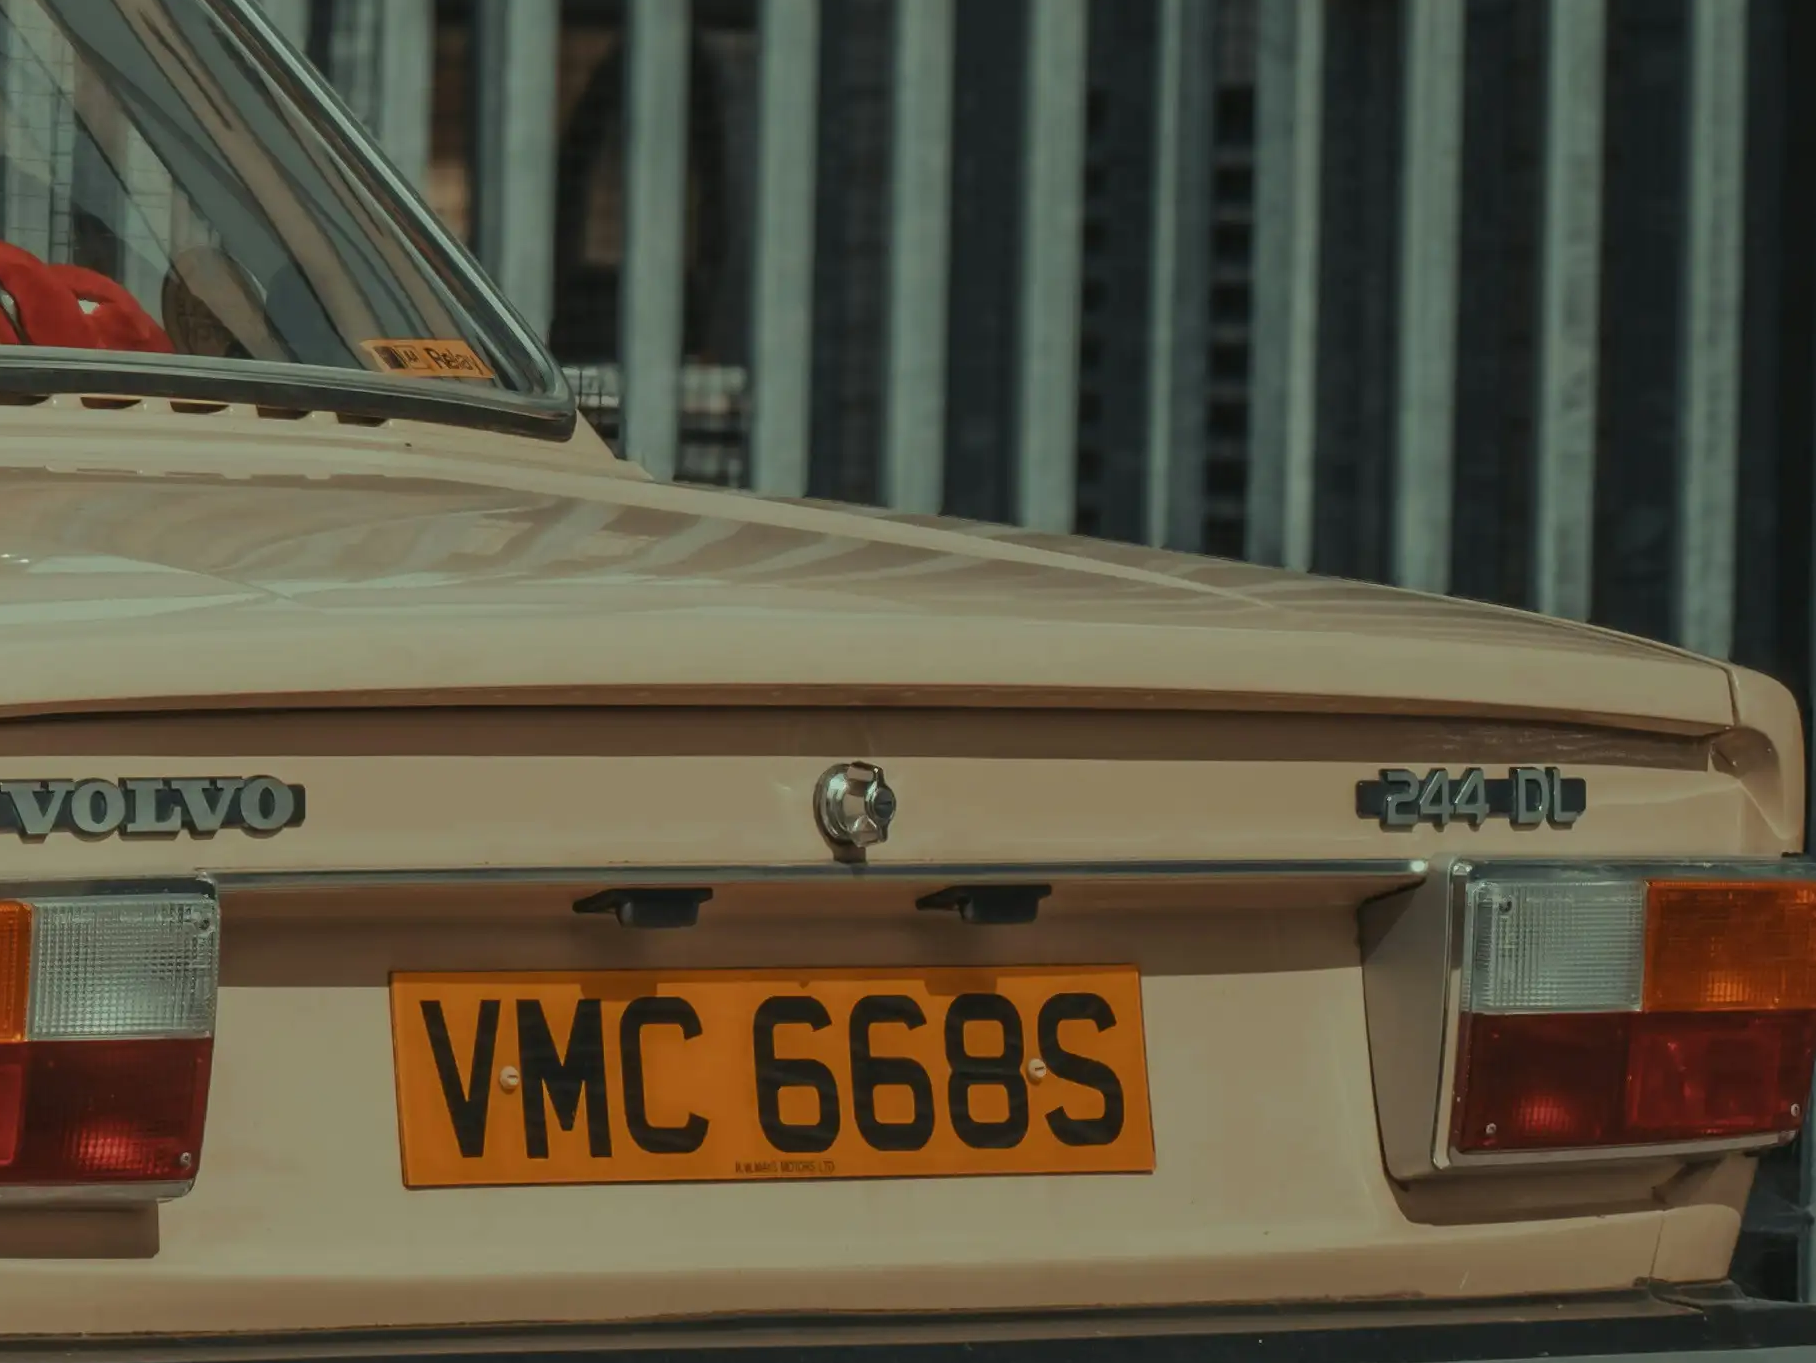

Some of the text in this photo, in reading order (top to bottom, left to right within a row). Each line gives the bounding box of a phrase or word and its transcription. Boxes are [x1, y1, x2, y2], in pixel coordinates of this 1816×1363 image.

[1384, 768, 1581, 827] 244 DL
[420, 992, 1126, 1160] VMC 668S
